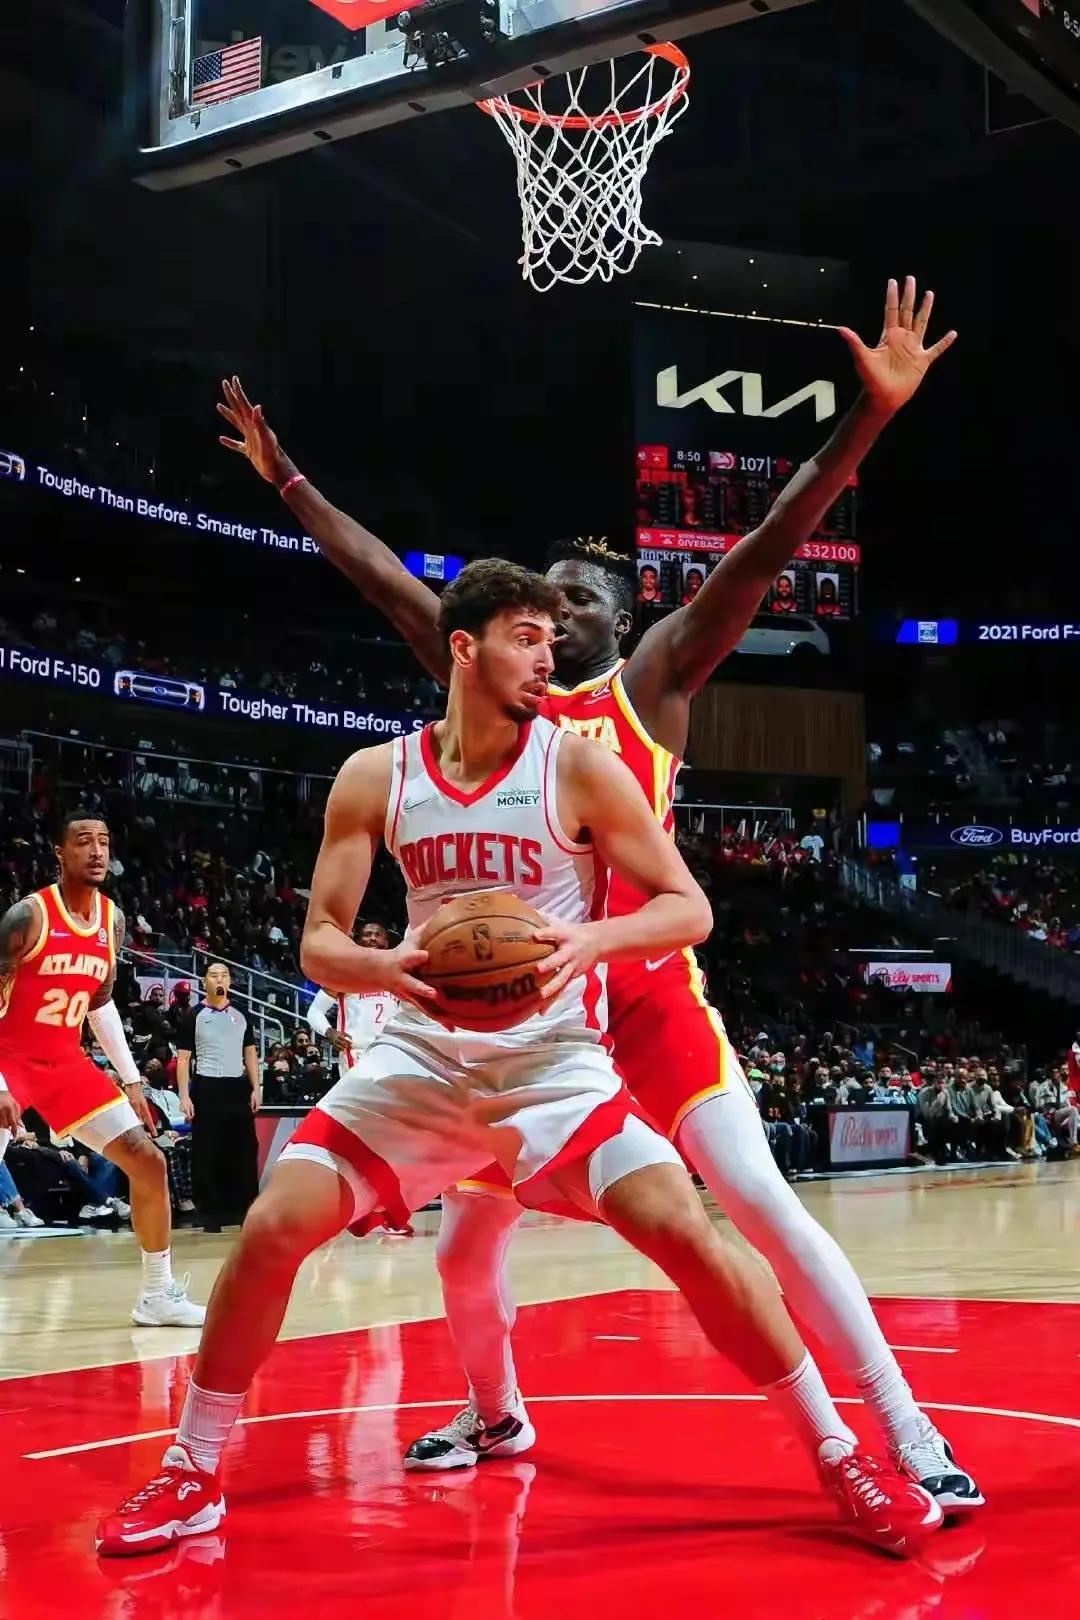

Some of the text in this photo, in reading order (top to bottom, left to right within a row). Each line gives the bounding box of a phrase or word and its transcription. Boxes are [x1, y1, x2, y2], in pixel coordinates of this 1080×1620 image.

[677, 450, 701, 462] 8:50
[740, 456, 766, 472] 107
[37, 466, 320, 553] Tougher Than Before. Smarter Than Ev
[803, 543, 857, 561] $32100
[978, 625, 1080, 640] 2021 Ford F-
[10, 650, 50, 677] Ford
[53, 659, 101, 688] F-150
[219, 691, 288, 720] Tougher
[292, 704, 339, 727] Than
[343, 711, 406, 735] Before.
[497, 795, 540, 807] MONEY
[959, 827, 994, 843] Ford
[399, 831, 544, 890] ROCKETS
[37, 953, 109, 983] ATLANTA
[34, 987, 91, 1028] 20
[374, 1003, 384, 1024] 2
